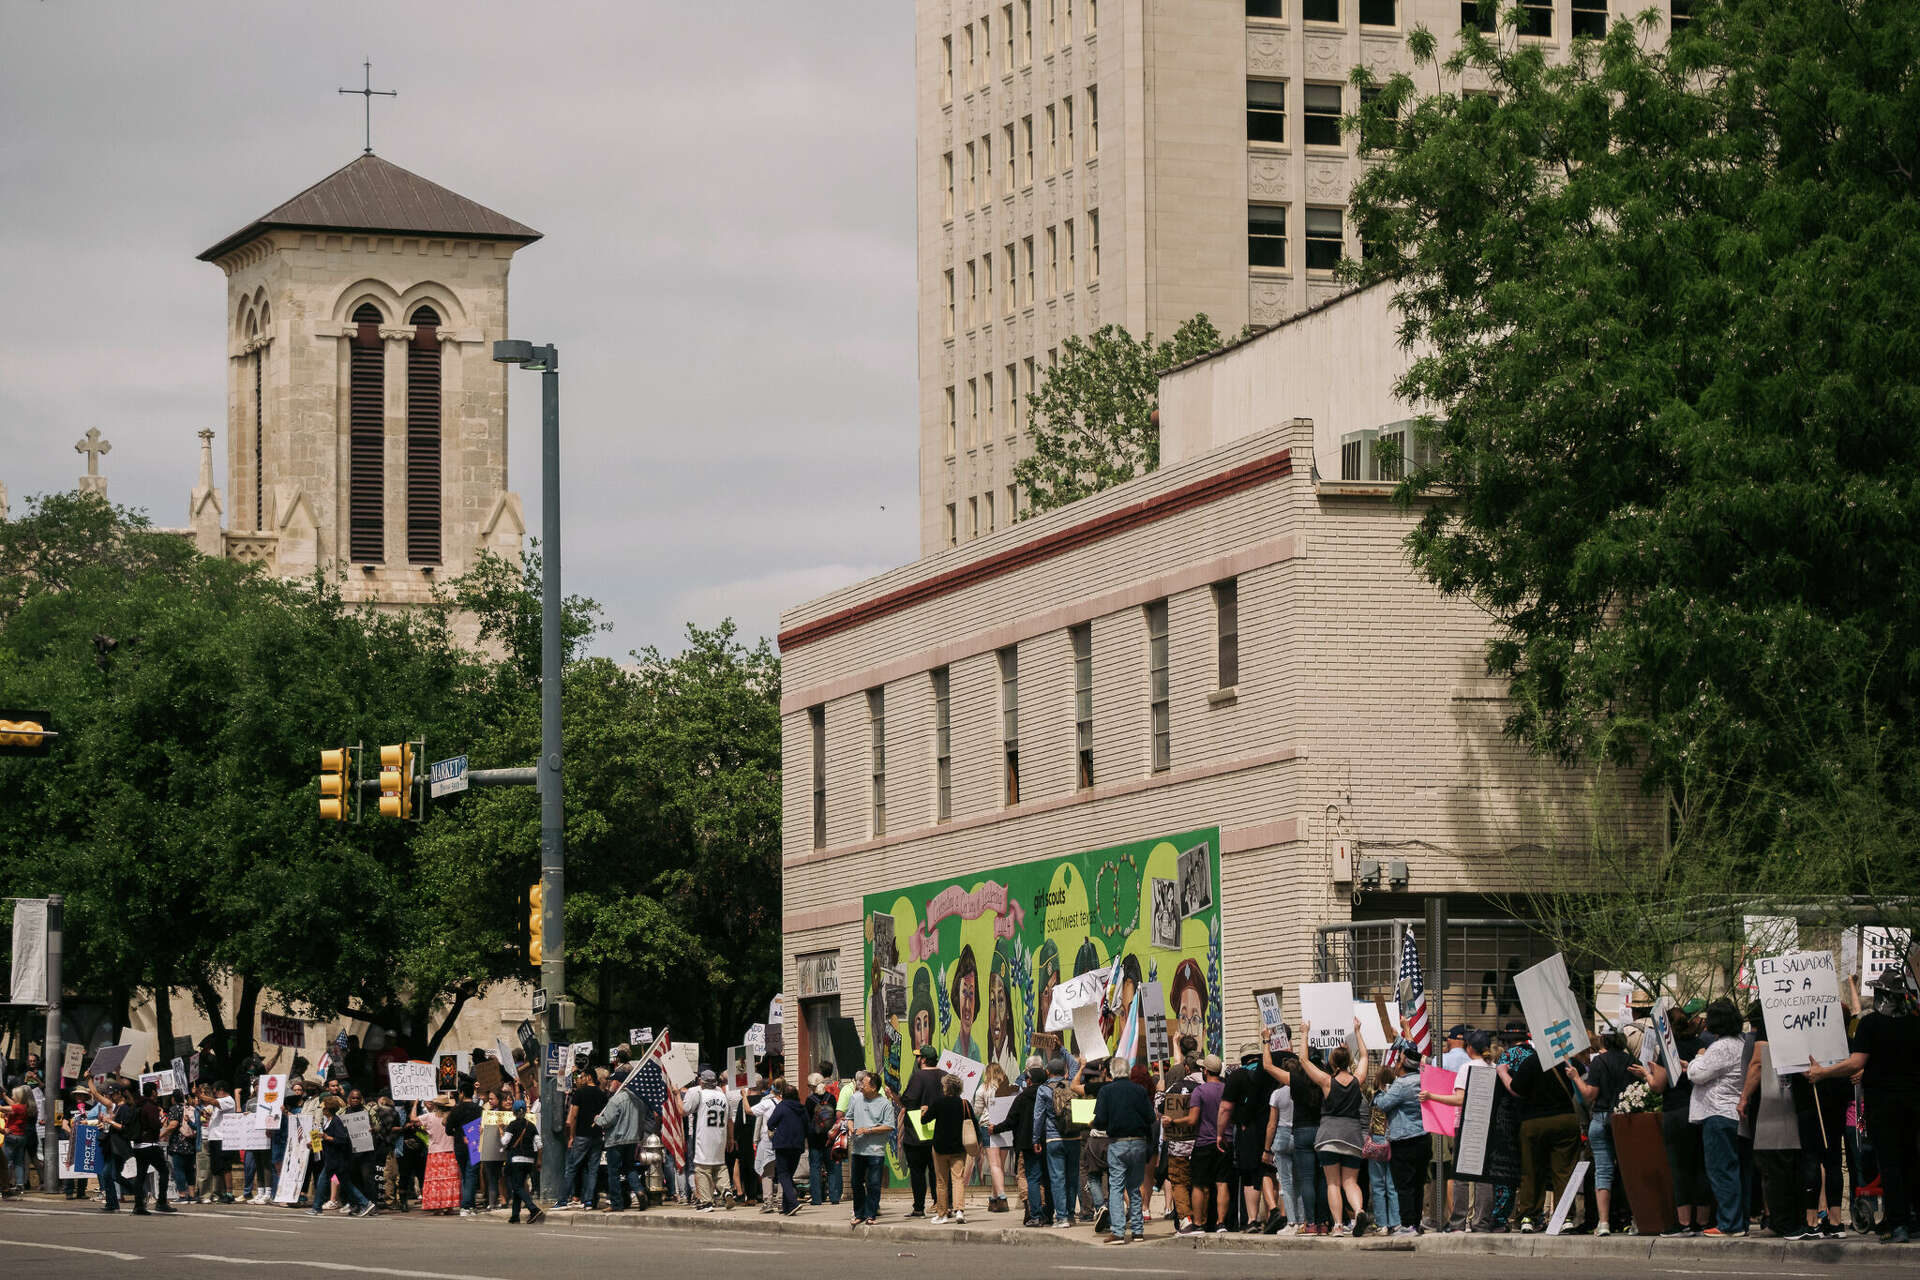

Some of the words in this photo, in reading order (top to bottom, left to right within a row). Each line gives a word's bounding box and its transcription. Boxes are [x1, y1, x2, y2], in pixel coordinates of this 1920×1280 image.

[432, 759, 459, 782] MARKET
[1034, 887, 1045, 914] girl
[1046, 888, 1066, 906] scouts
[1046, 912, 1079, 934] southwest
[1080, 909, 1097, 925] texas
[817, 956, 837, 973] BOOKS
[1761, 960, 1778, 974] EL
[1783, 955, 1834, 974] SALVADOR
[1774, 979, 1795, 993] IS
[1802, 977, 1812, 991] A
[1765, 994, 1839, 1010] CONCENTRATION
[1783, 1005, 1828, 1031] CAMP!!
[410, 1065, 432, 1077] ELON
[707, 1110, 725, 1127] 21
